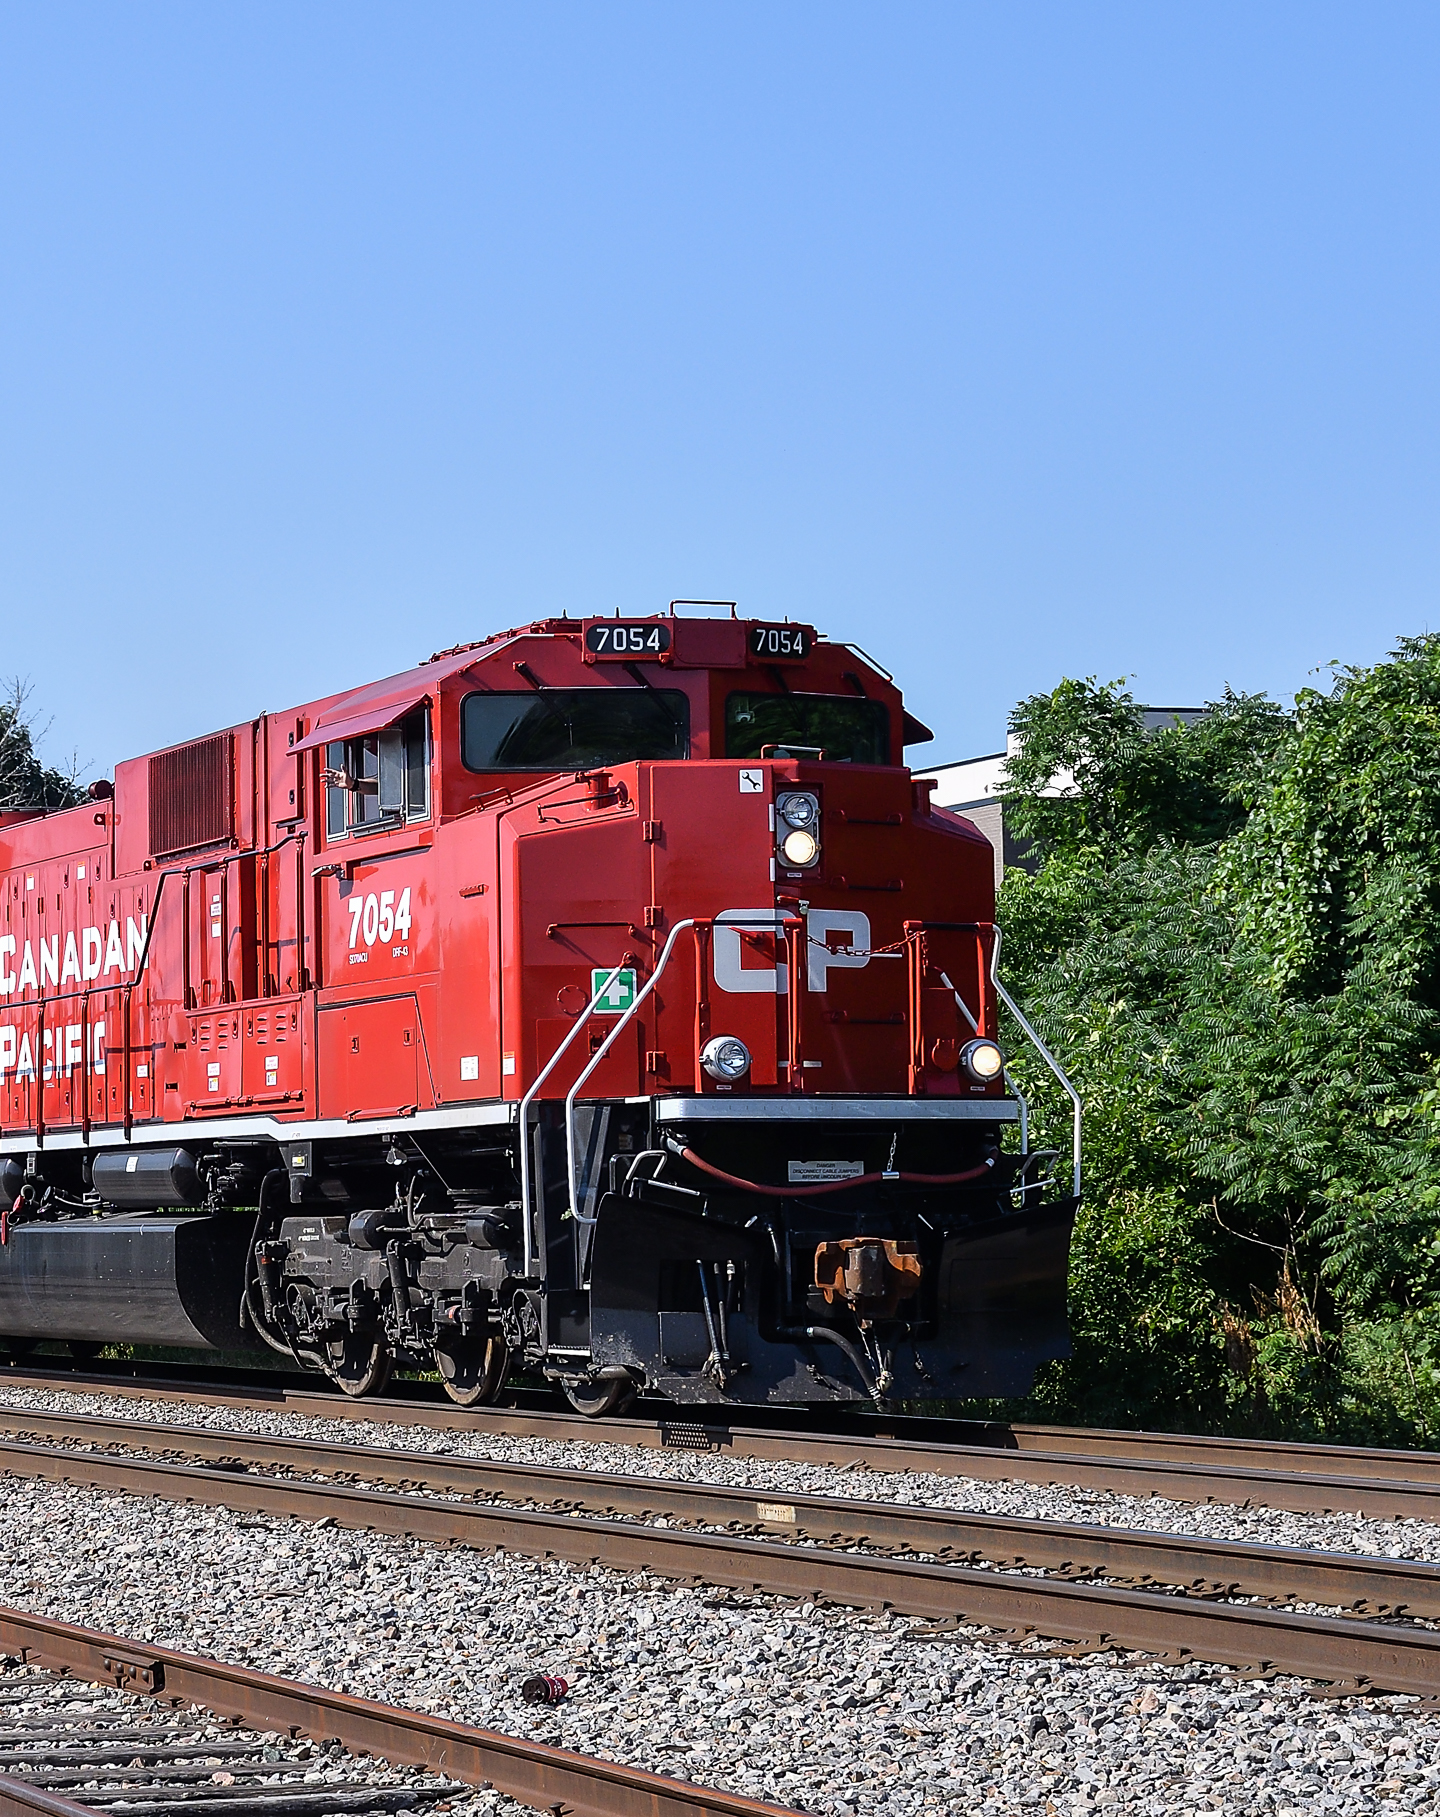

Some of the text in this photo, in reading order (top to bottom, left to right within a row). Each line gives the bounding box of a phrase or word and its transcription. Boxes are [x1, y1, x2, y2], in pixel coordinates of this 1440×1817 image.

[596, 627, 661, 651] 7054
[755, 629, 803, 655] 7054
[348, 886, 412, 949] 7054
[713, 908, 871, 995] CP
